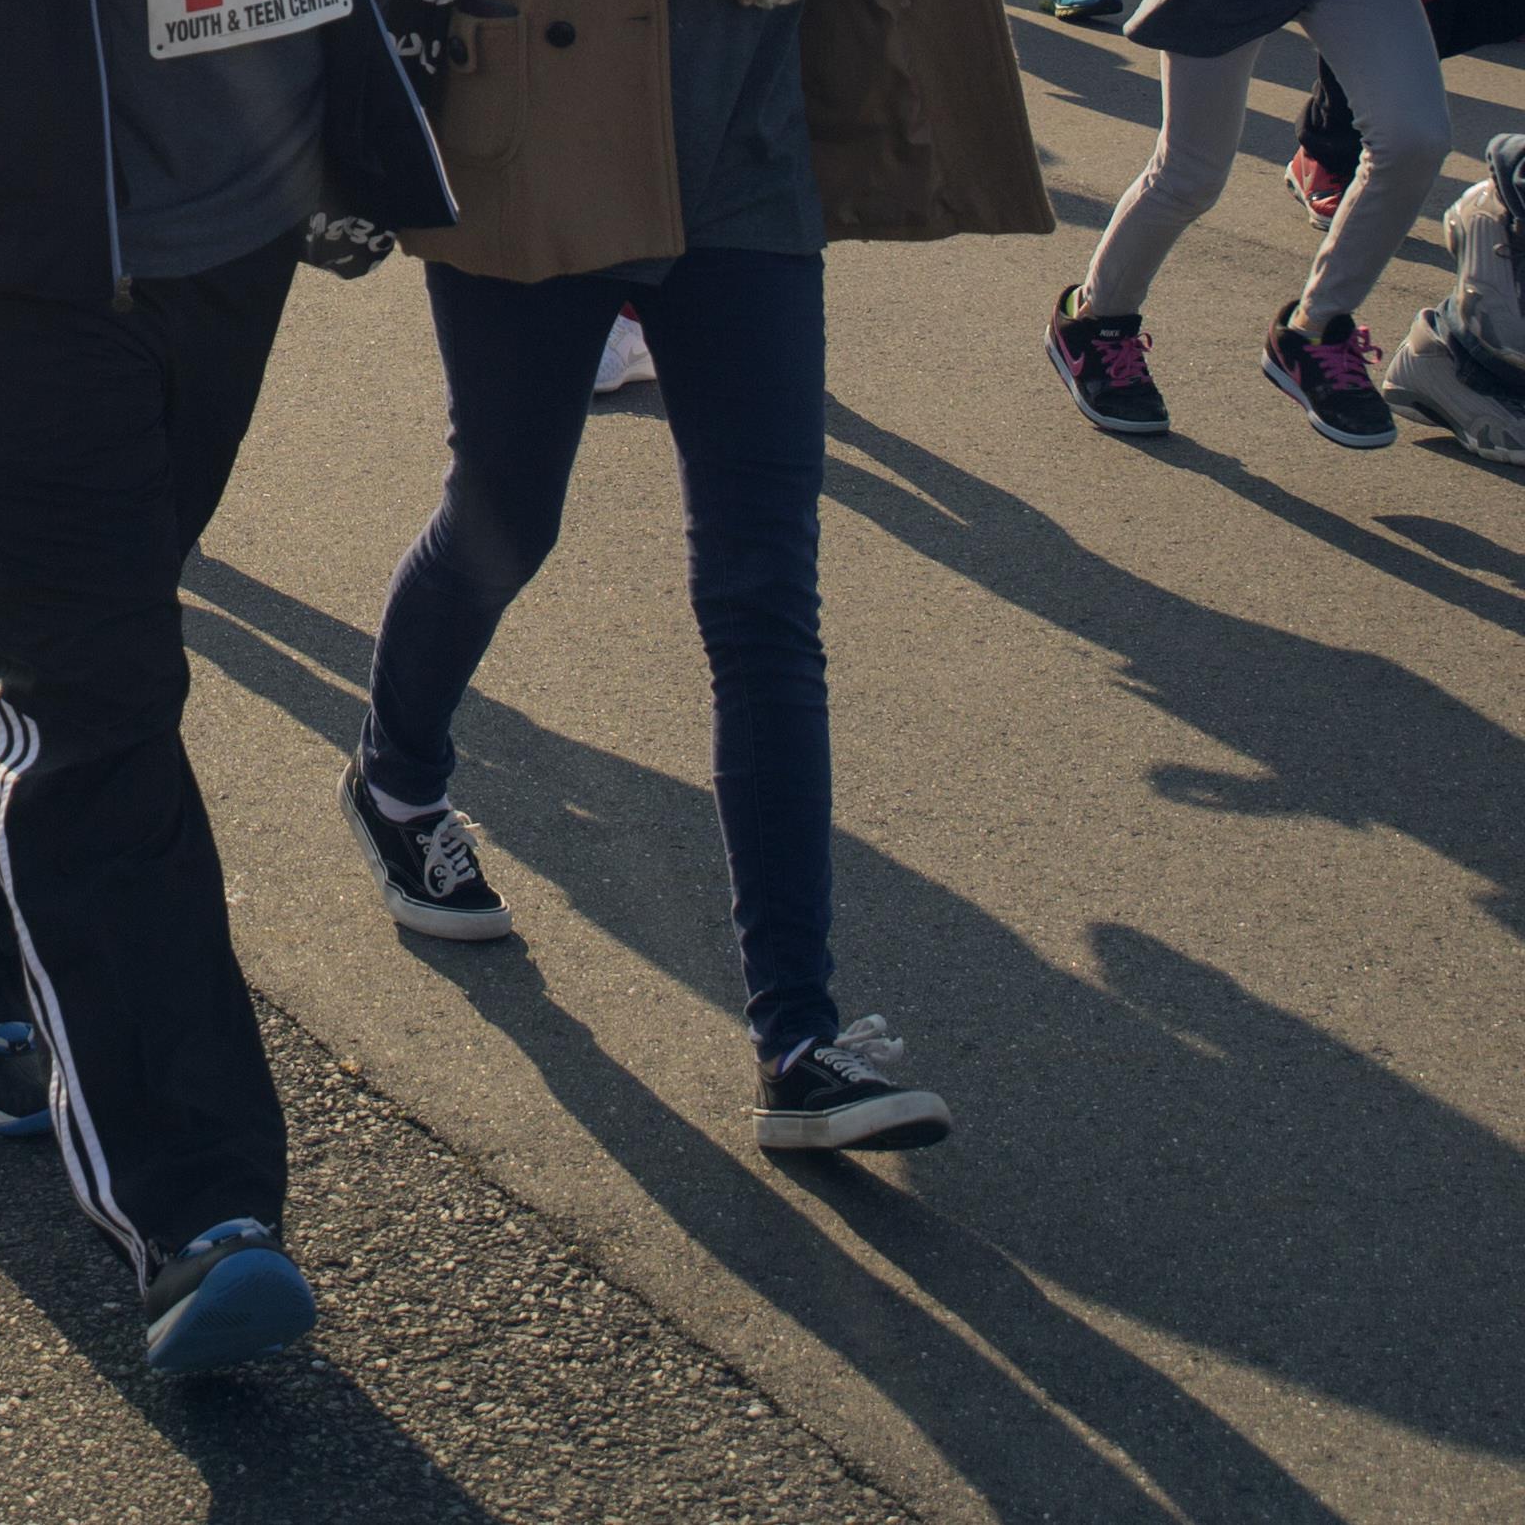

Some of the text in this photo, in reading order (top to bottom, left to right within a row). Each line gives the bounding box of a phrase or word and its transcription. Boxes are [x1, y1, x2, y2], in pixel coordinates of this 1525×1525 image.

[165, 8, 223, 44] YOUTH
[228, 7, 241, 32] &
[1099, 328, 1121, 338] NIKE
